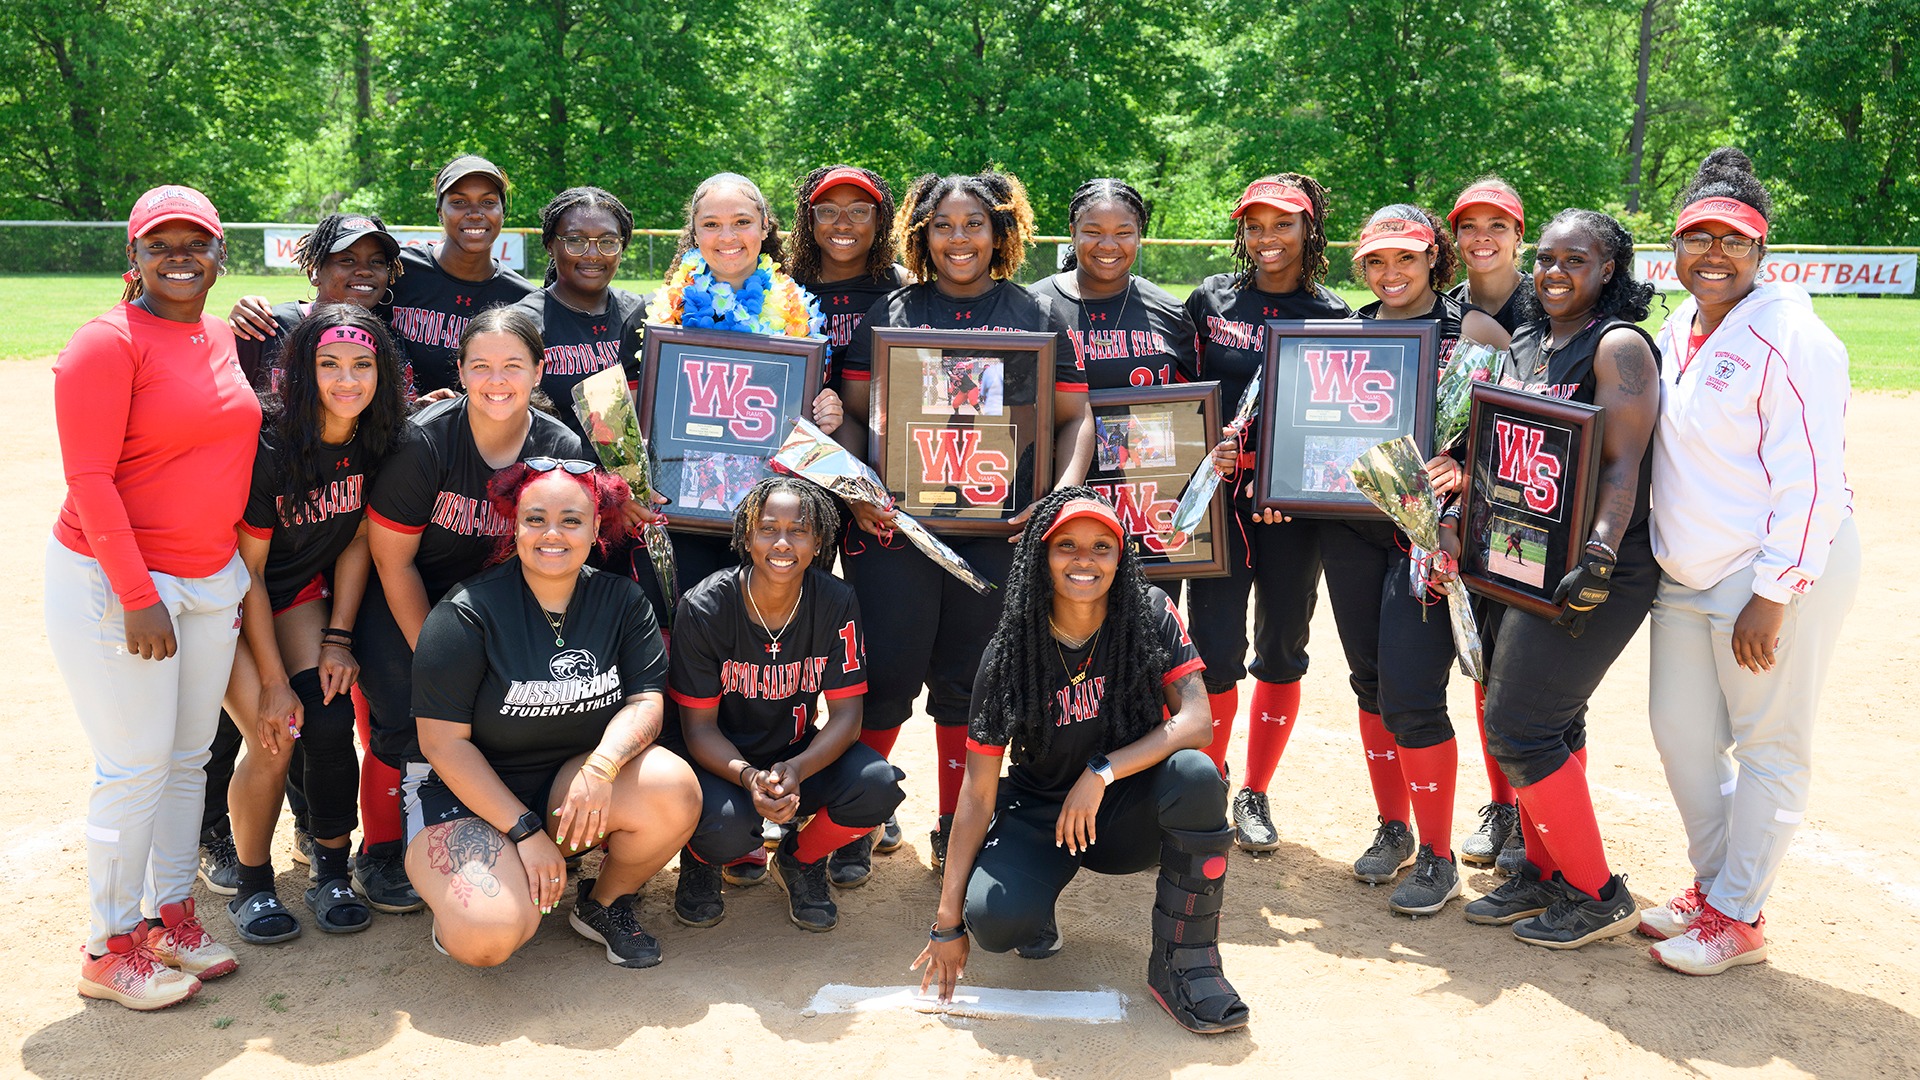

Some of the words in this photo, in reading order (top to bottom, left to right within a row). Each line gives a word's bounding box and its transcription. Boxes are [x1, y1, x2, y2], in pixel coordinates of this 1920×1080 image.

[1763, 262, 1903, 285] SOFTBALL
[683, 359, 778, 442] WS
[746, 410, 765, 418] RAMS
[1304, 349, 1396, 424] WS
[912, 428, 1009, 506] WS
[1495, 418, 1561, 514] WS
[499, 688, 623, 718] STUDENT-ATHLETE
